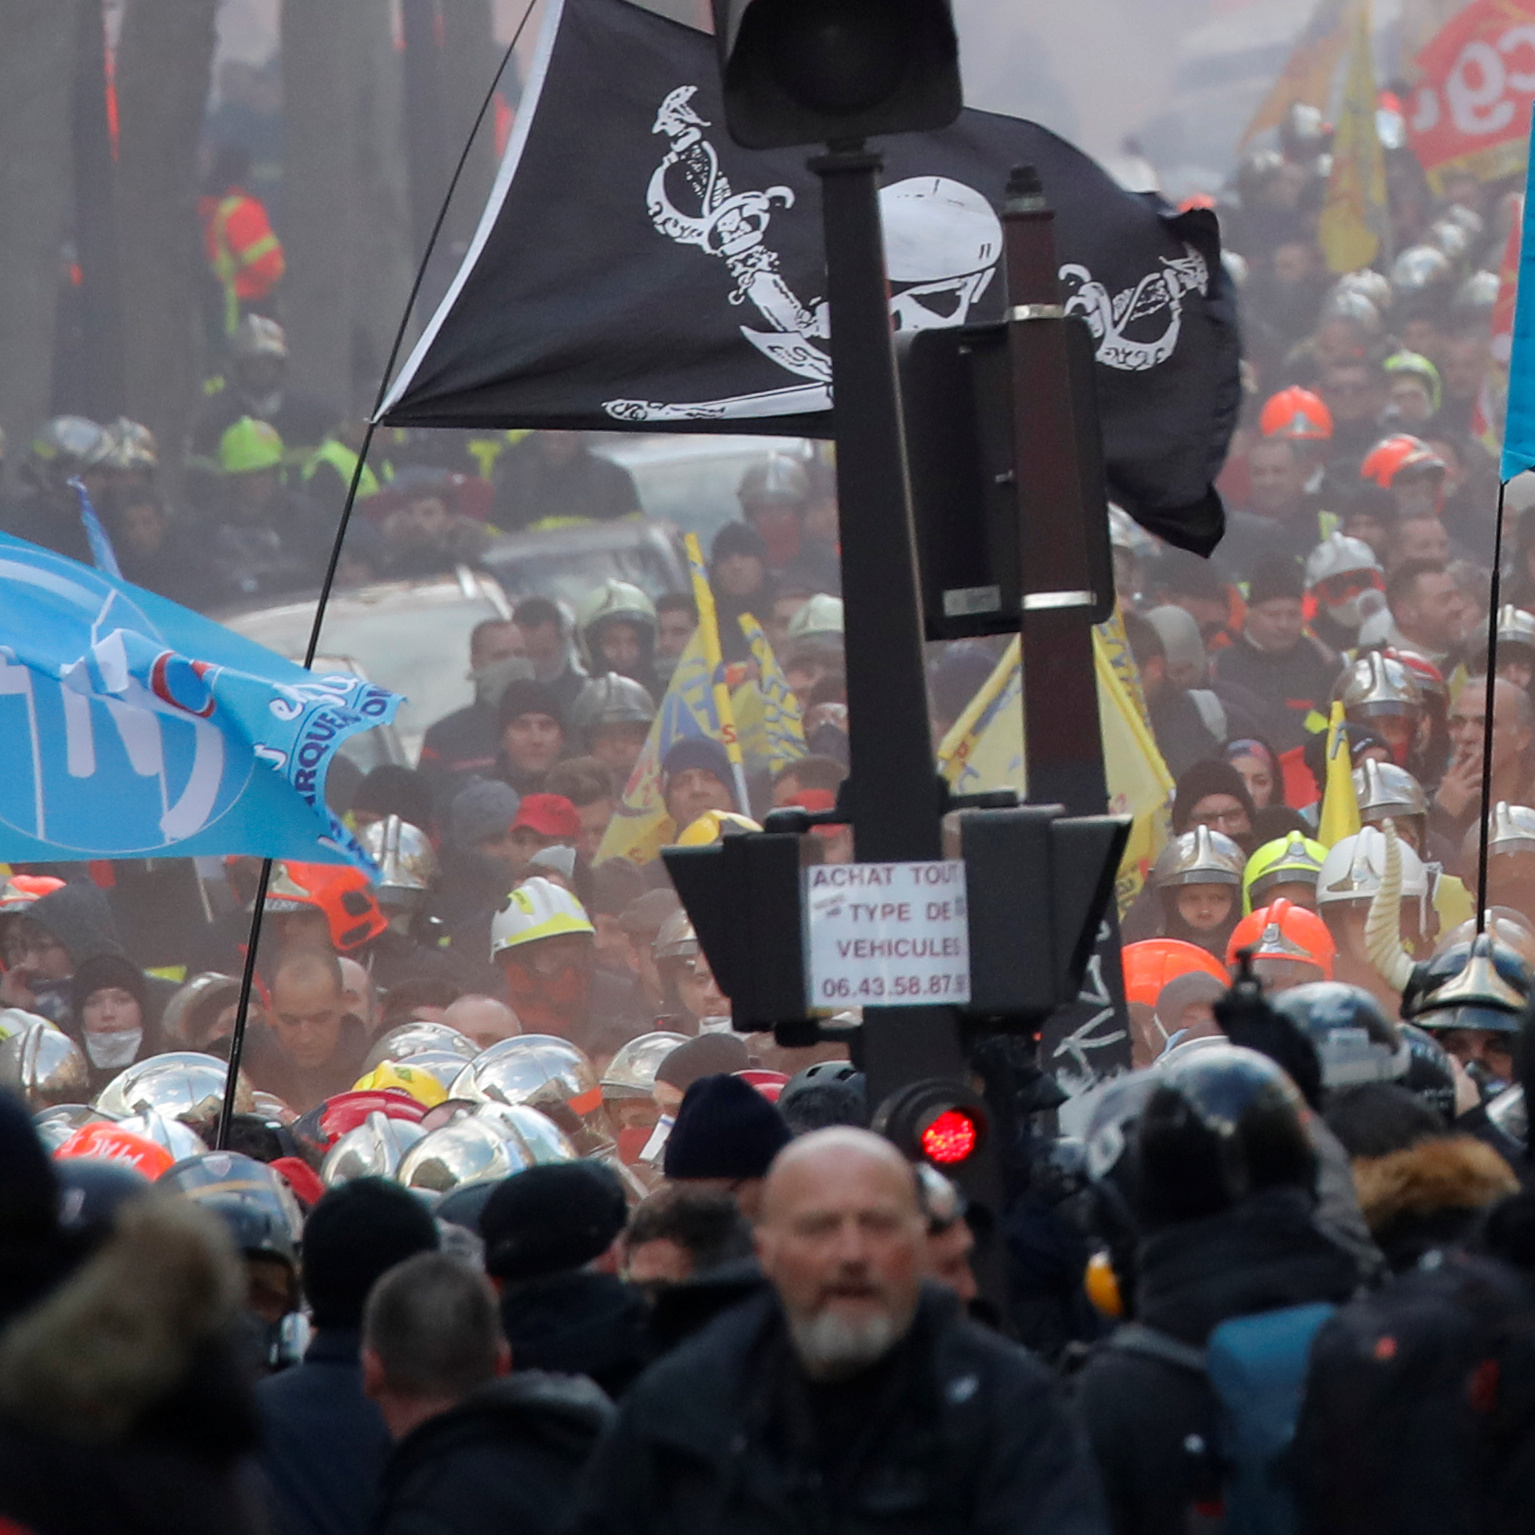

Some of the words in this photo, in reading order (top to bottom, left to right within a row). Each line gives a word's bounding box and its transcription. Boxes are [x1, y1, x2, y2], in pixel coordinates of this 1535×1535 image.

[813, 866, 894, 887] ACHAT
[910, 864, 957, 885] TOUT
[849, 902, 912, 922] TYPE
[926, 900, 951, 921] DE
[837, 937, 960, 958] VEHICULES
